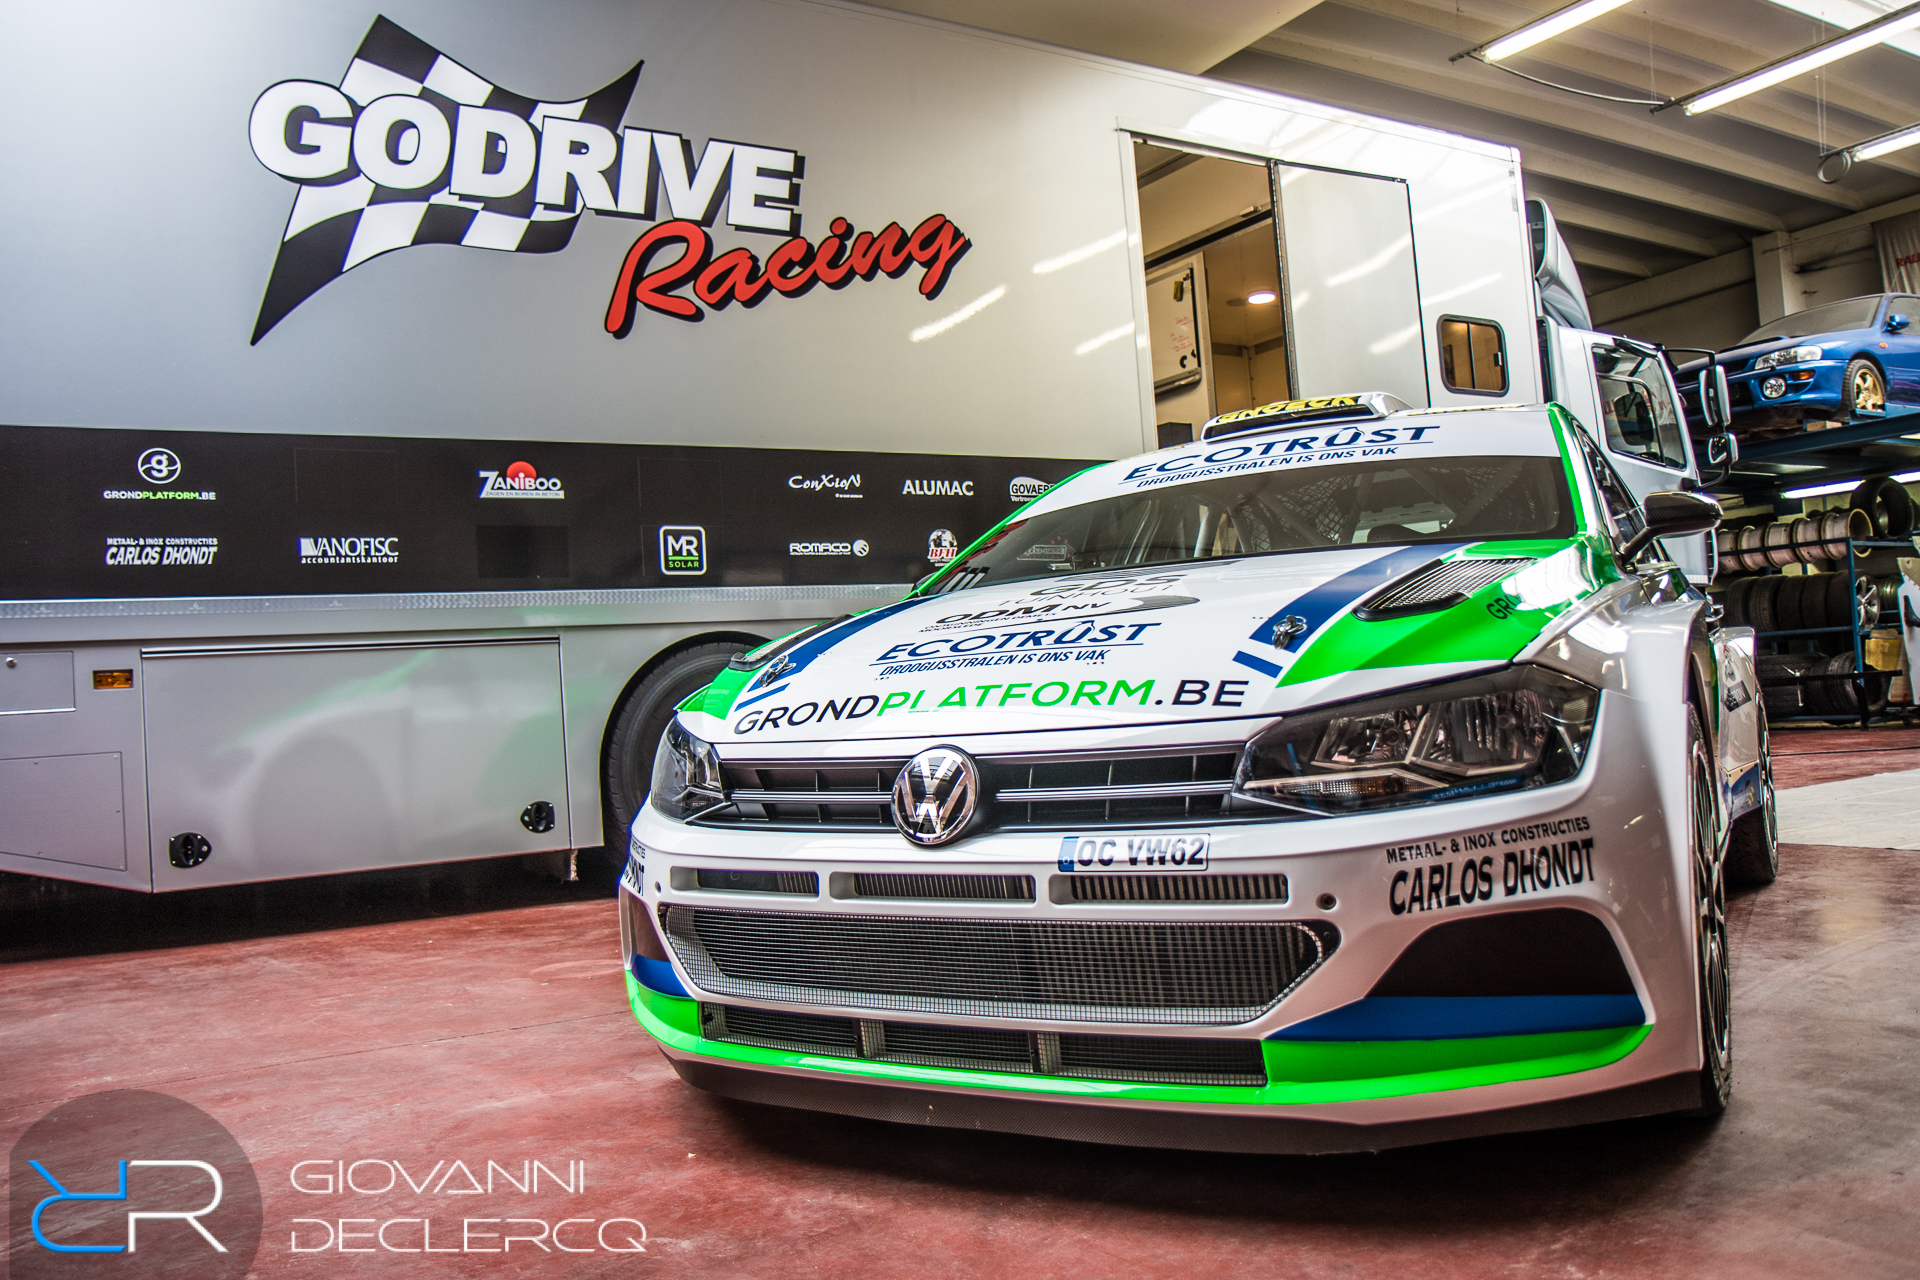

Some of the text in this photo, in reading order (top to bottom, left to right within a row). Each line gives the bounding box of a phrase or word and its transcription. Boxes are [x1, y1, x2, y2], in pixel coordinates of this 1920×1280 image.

[248, 78, 805, 237] GODRIVE
[604, 213, 972, 338] Racing
[1297, 454, 1313, 464] IS
[1320, 449, 1356, 460] ONS
[1362, 446, 1399, 457] VAK
[103, 490, 217, 500] GRONDPLATFORM.BE
[902, 479, 975, 496] ALUMAC
[301, 537, 399, 556] VANOFISC
[666, 535, 699, 556] MR
[789, 542, 852, 553] ROMACO
[929, 548, 956, 558] BFH
[105, 546, 218, 565] CARLOS DHONDT
[301, 555, 399, 564] accountantskantoor
[1061, 601, 1112, 611] NV
[1018, 653, 1036, 664] IS
[1037, 652, 1070, 663] ONS
[1075, 650, 1111, 661] VAK
[1386, 816, 1590, 864] METAAL- & INOX CONSTRUCTIES
[1077, 837, 1205, 867] OC VW62
[1389, 837, 1595, 916] CARLOS DHONDT
